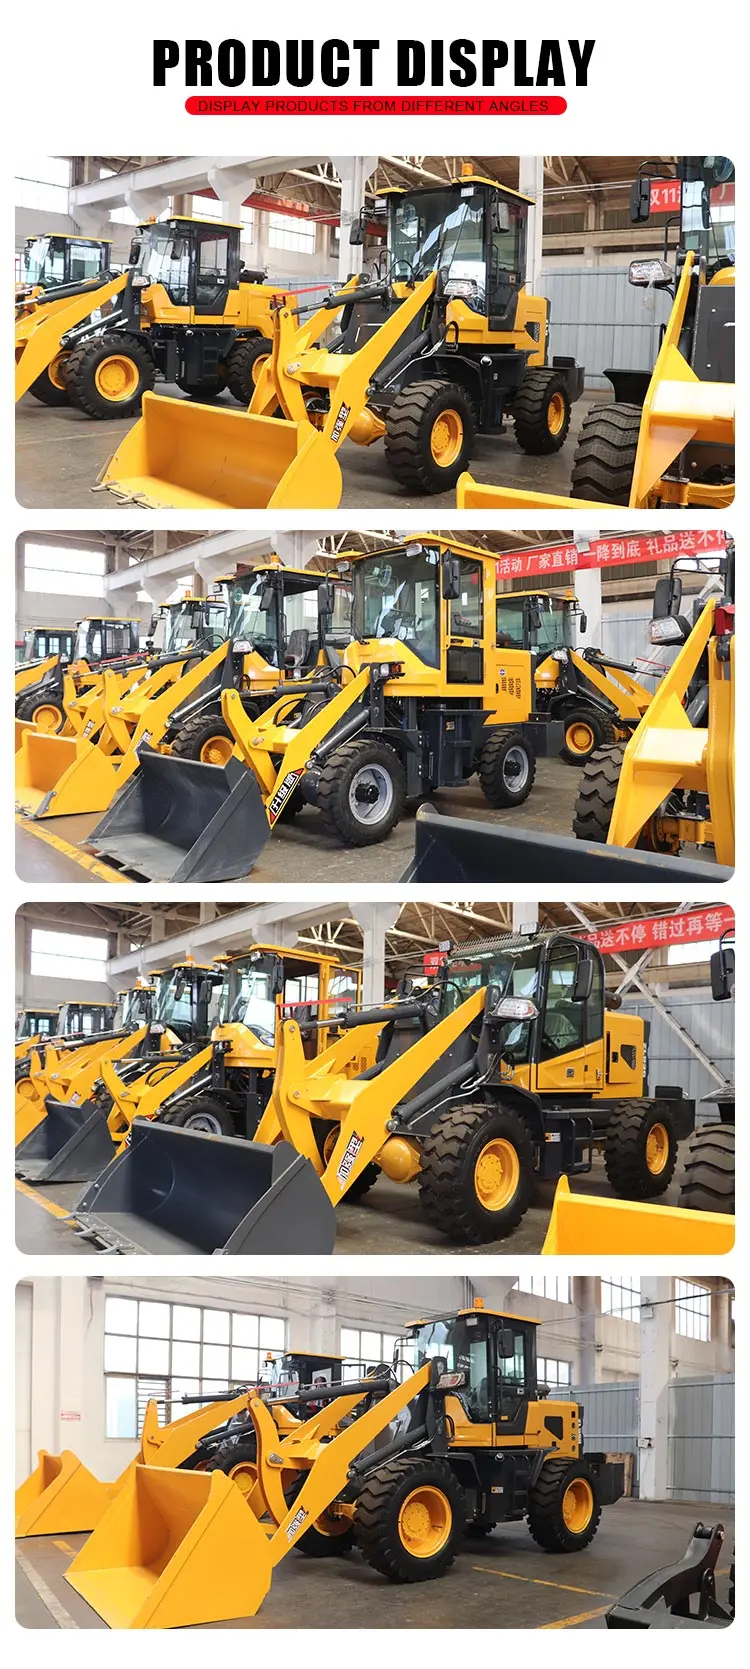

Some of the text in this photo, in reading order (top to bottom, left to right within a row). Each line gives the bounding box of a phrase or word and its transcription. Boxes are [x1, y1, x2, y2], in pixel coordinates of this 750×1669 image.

[650, 185, 681, 206] 双11
[526, 547, 578, 571] 厂家直销
[583, 540, 641, 562] 一降到底
[271, 773, 297, 811] 升级版
[652, 912, 735, 941] 错过再等一
